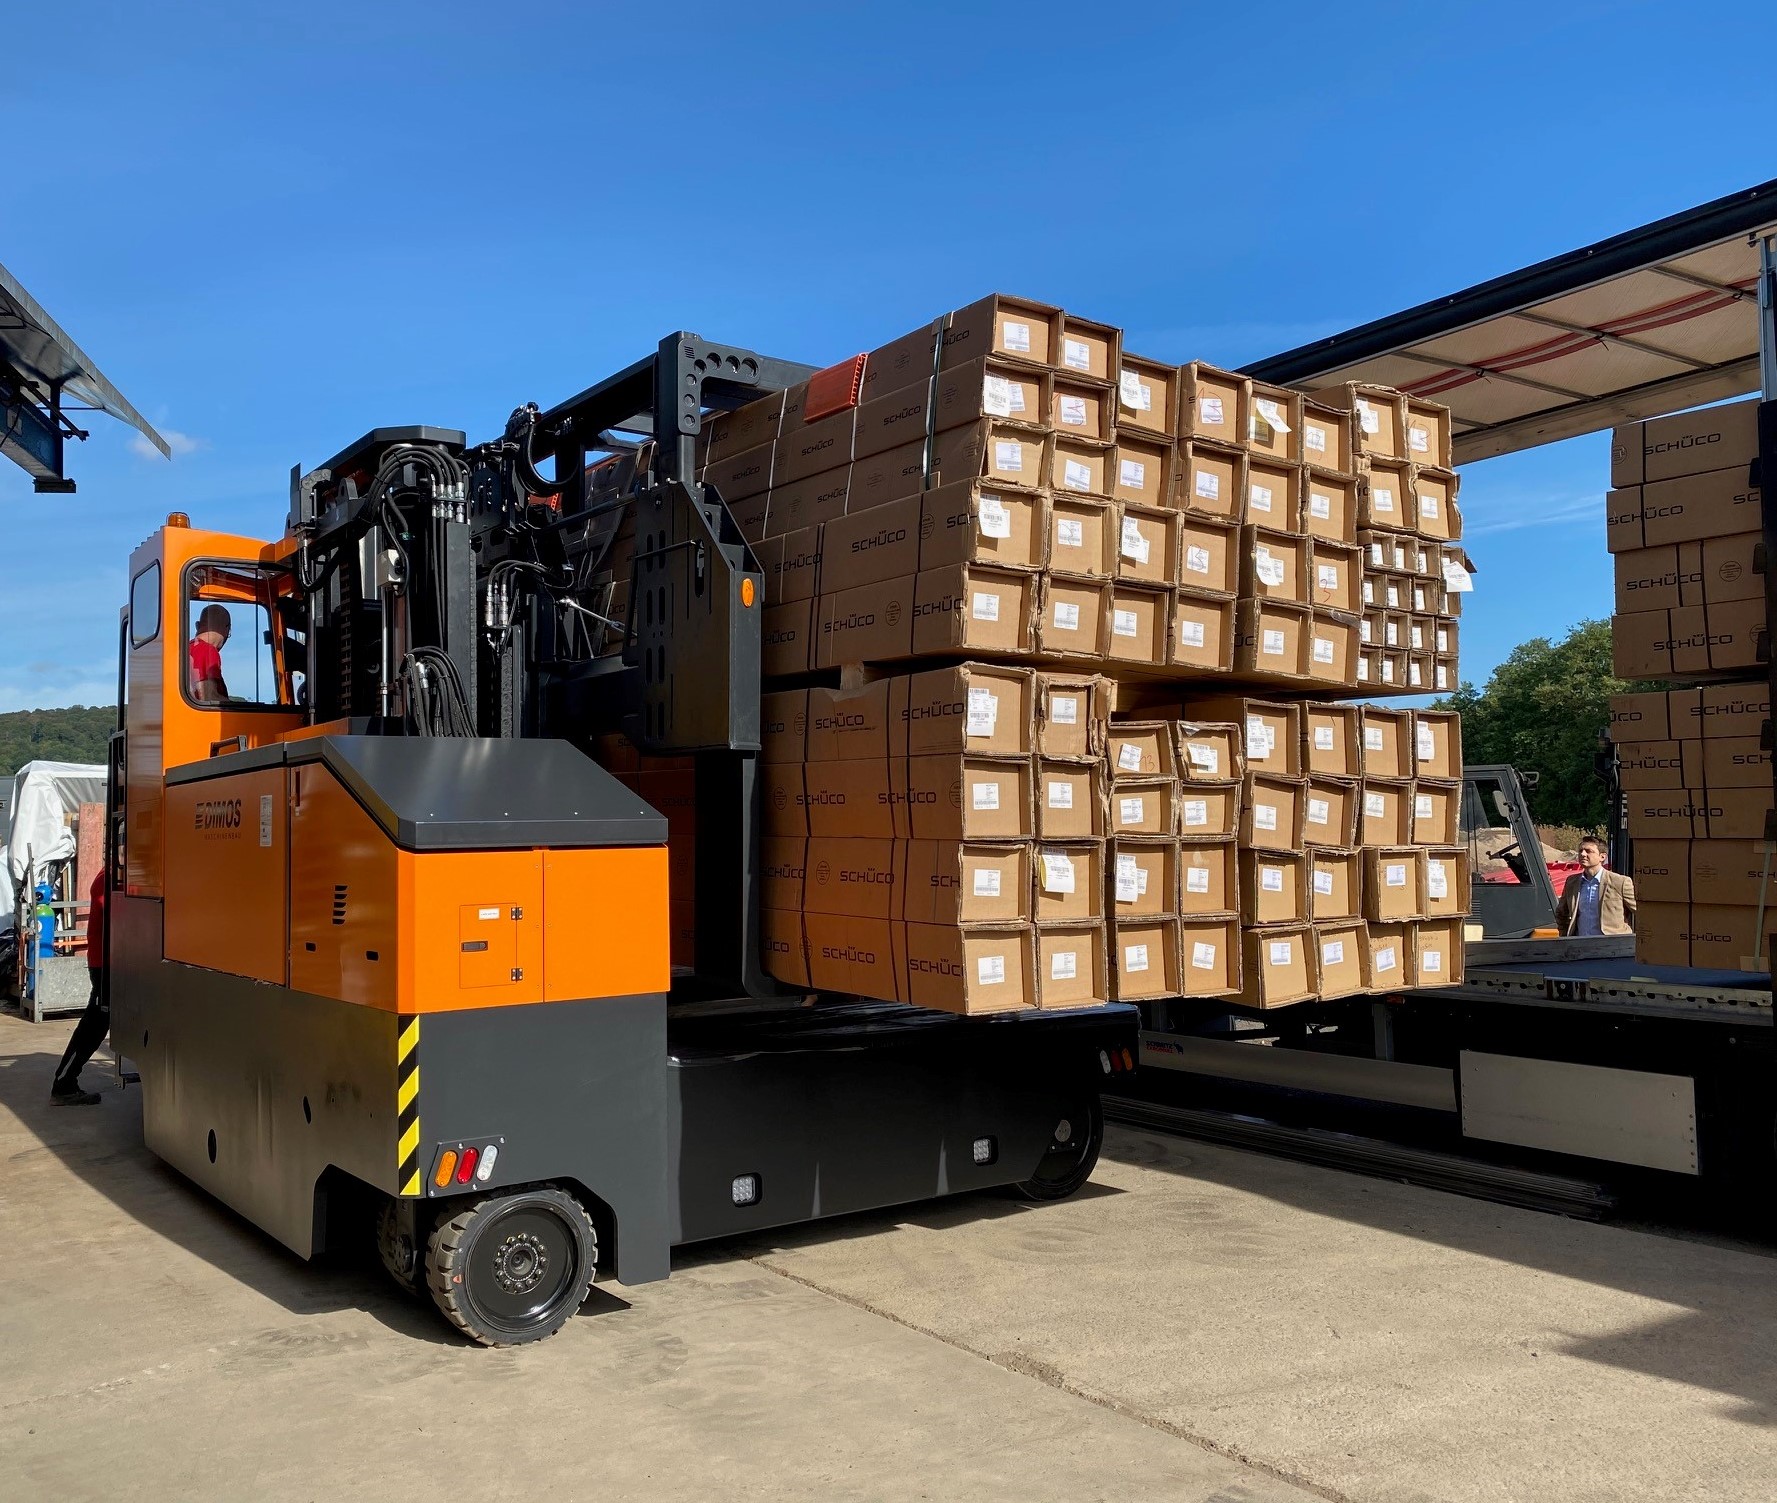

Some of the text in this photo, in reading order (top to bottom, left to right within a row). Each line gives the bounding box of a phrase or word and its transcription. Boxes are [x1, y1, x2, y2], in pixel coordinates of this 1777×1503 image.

[930, 330, 970, 353] SHÜCO
[883, 405, 921, 426] SCHÜCO
[801, 438, 834, 456] SCHÜCO
[1644, 433, 1721, 456] SCHÜCO
[1608, 505, 1684, 527] SCHÜCO
[851, 529, 906, 553] SCHÜCO
[774, 553, 823, 574] SCHÜCO
[1626, 572, 1703, 591] SCHÜCO
[913, 595, 965, 618] SCHÜC
[824, 613, 875, 633] SCHÜCO
[1654, 632, 1733, 651] SCHÜCO
[901, 701, 965, 721] SCHÜCO
[815, 712, 865, 730] SCHÜCO
[1732, 754, 1773, 765] SCH
[796, 790, 846, 805] SCHÜCO
[878, 787, 937, 805] SCHÜCO
[205, 798, 242, 829] DIMOS
[1644, 805, 1724, 818] SCHÜCO
[839, 867, 895, 885] SCHÜCO
[1635, 866, 1669, 876] HÜCO
[1748, 870, 1776, 878] SCH
[930, 875, 961, 888] SCH
[1680, 932, 1732, 942] SCHÜCO
[822, 946, 875, 964] SCHÜCO
[909, 958, 964, 977] SCHÜC
